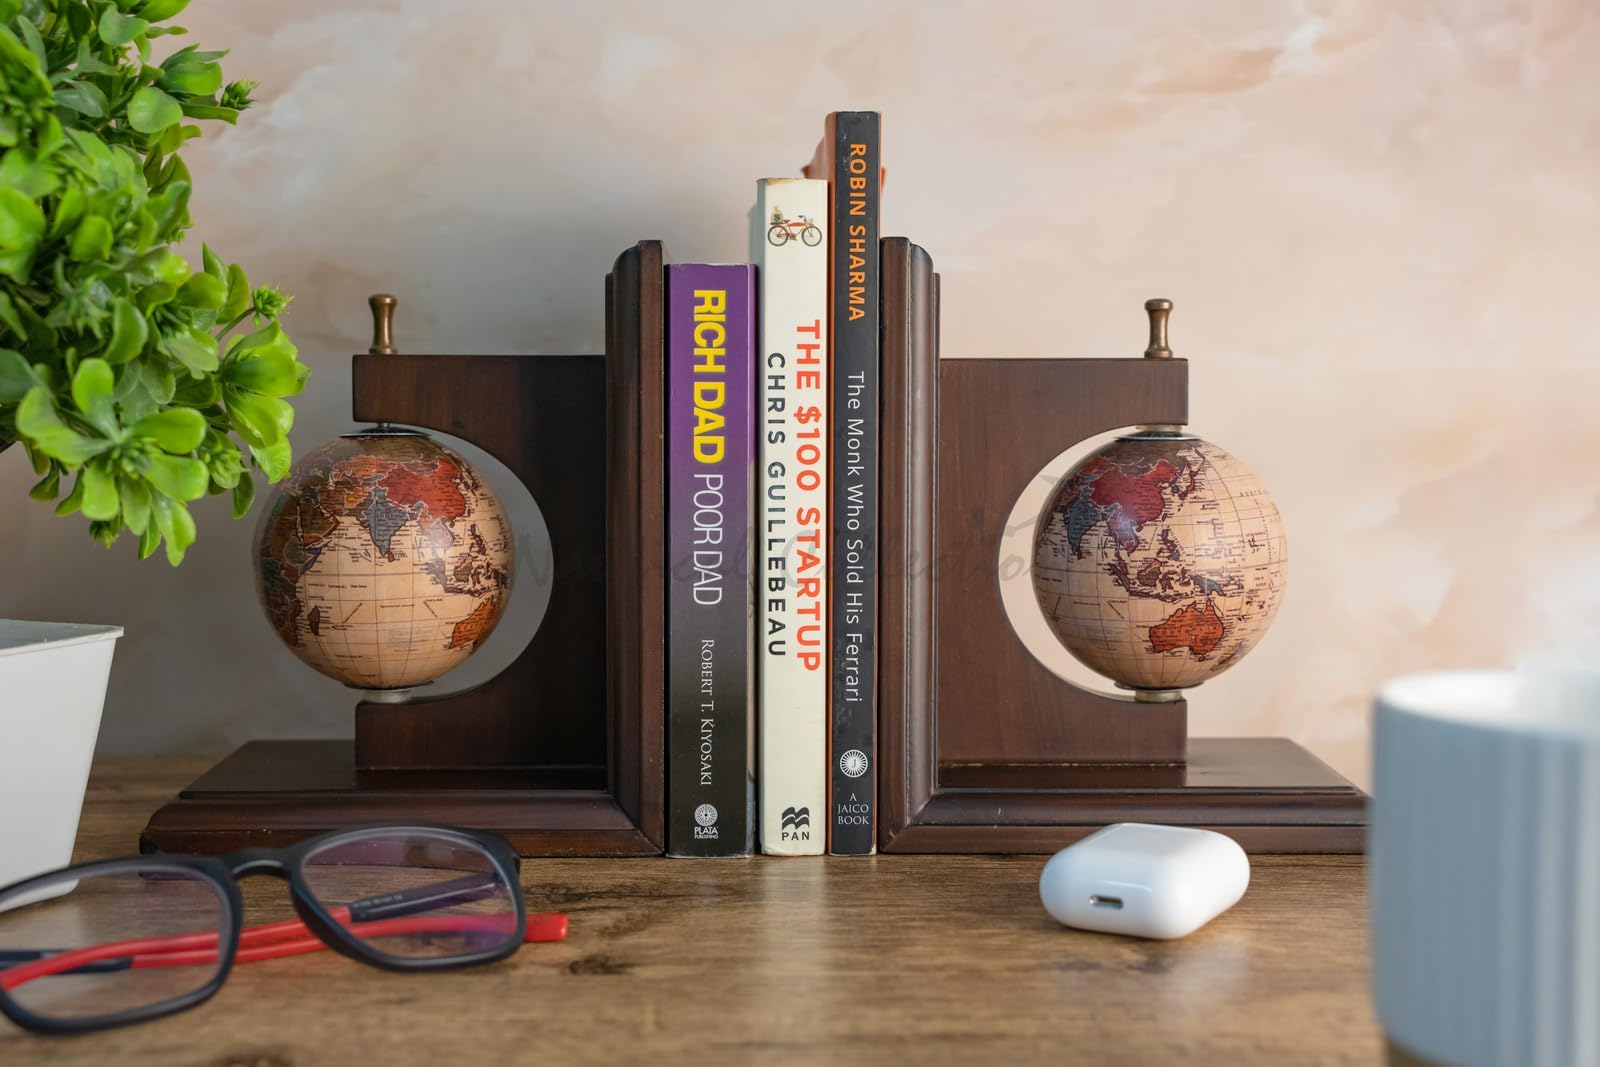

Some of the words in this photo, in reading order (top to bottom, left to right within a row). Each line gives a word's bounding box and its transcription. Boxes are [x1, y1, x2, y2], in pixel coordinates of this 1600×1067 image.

[849, 143, 867, 216] ROBIN
[848, 225, 866, 321] SHARMA
[694, 290, 726, 372] RICH
[796, 319, 821, 390] THE
[767, 352, 786, 445] CHRIS
[847, 370, 865, 410] The
[694, 382, 725, 464] DAD
[793, 405, 822, 492] $100
[847, 418, 865, 476] Monk
[692, 473, 724, 545] POOR
[846, 483, 865, 531] Who
[692, 550, 723, 606] DAD
[767, 461, 786, 656] GUILLEBEAU
[846, 539, 864, 583] Sold
[796, 507, 821, 671] STARTUP
[846, 593, 863, 624] His
[701, 639, 715, 696] ROBERT
[845, 633, 863, 702] Ferrari
[701, 700, 714, 713] T.
[700, 718, 714, 785] KIYOSAKI
[837, 803, 870, 815] JAICO
[838, 815, 870, 825] BOOK
[849, 792, 858, 802] A
[694, 826, 718, 835] PLATA
[781, 831, 810, 841] PAN
